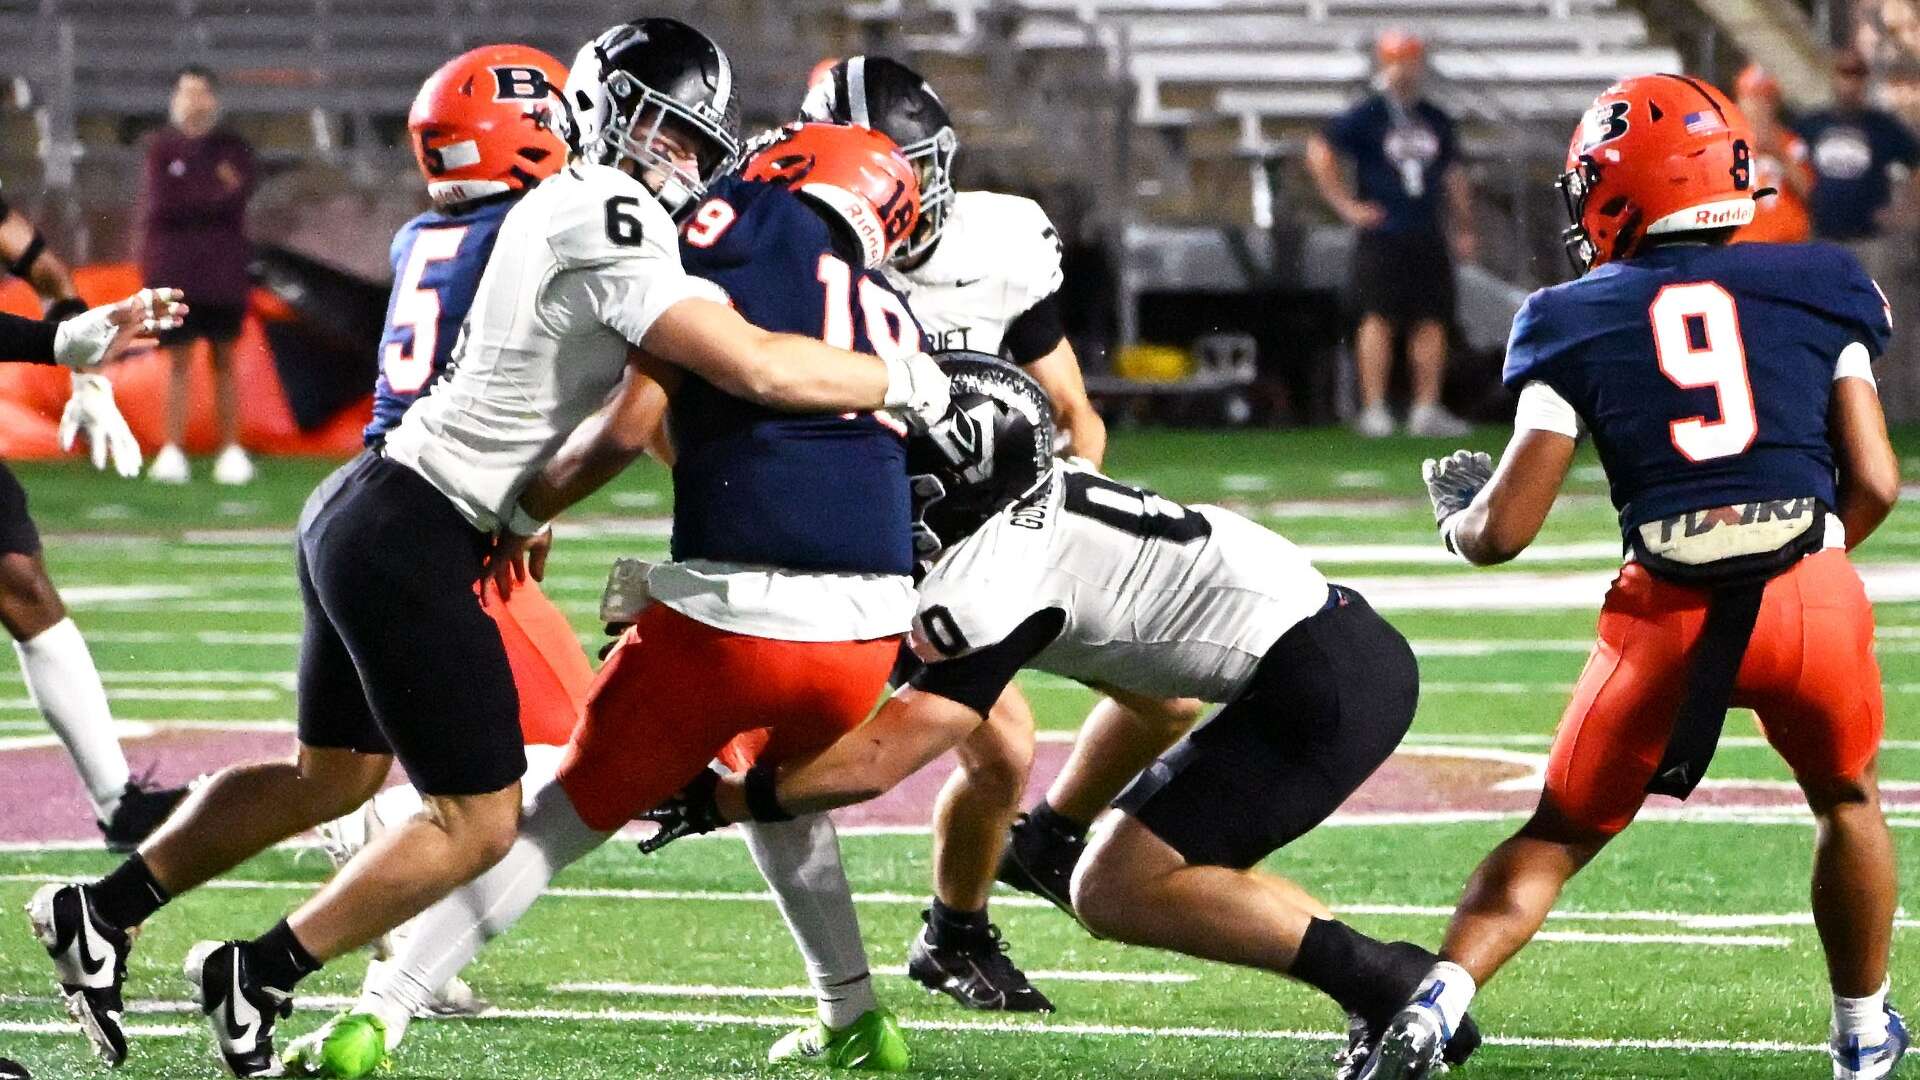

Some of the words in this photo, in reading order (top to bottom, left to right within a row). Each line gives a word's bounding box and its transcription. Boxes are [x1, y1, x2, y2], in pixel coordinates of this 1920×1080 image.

[490, 64, 551, 102] B
[421, 126, 450, 176] 5
[604, 195, 643, 247] 6
[384, 226, 470, 395] 5
[1648, 279, 1758, 464] 9
[1063, 470, 1212, 546] 0
[920, 603, 970, 657] 0
